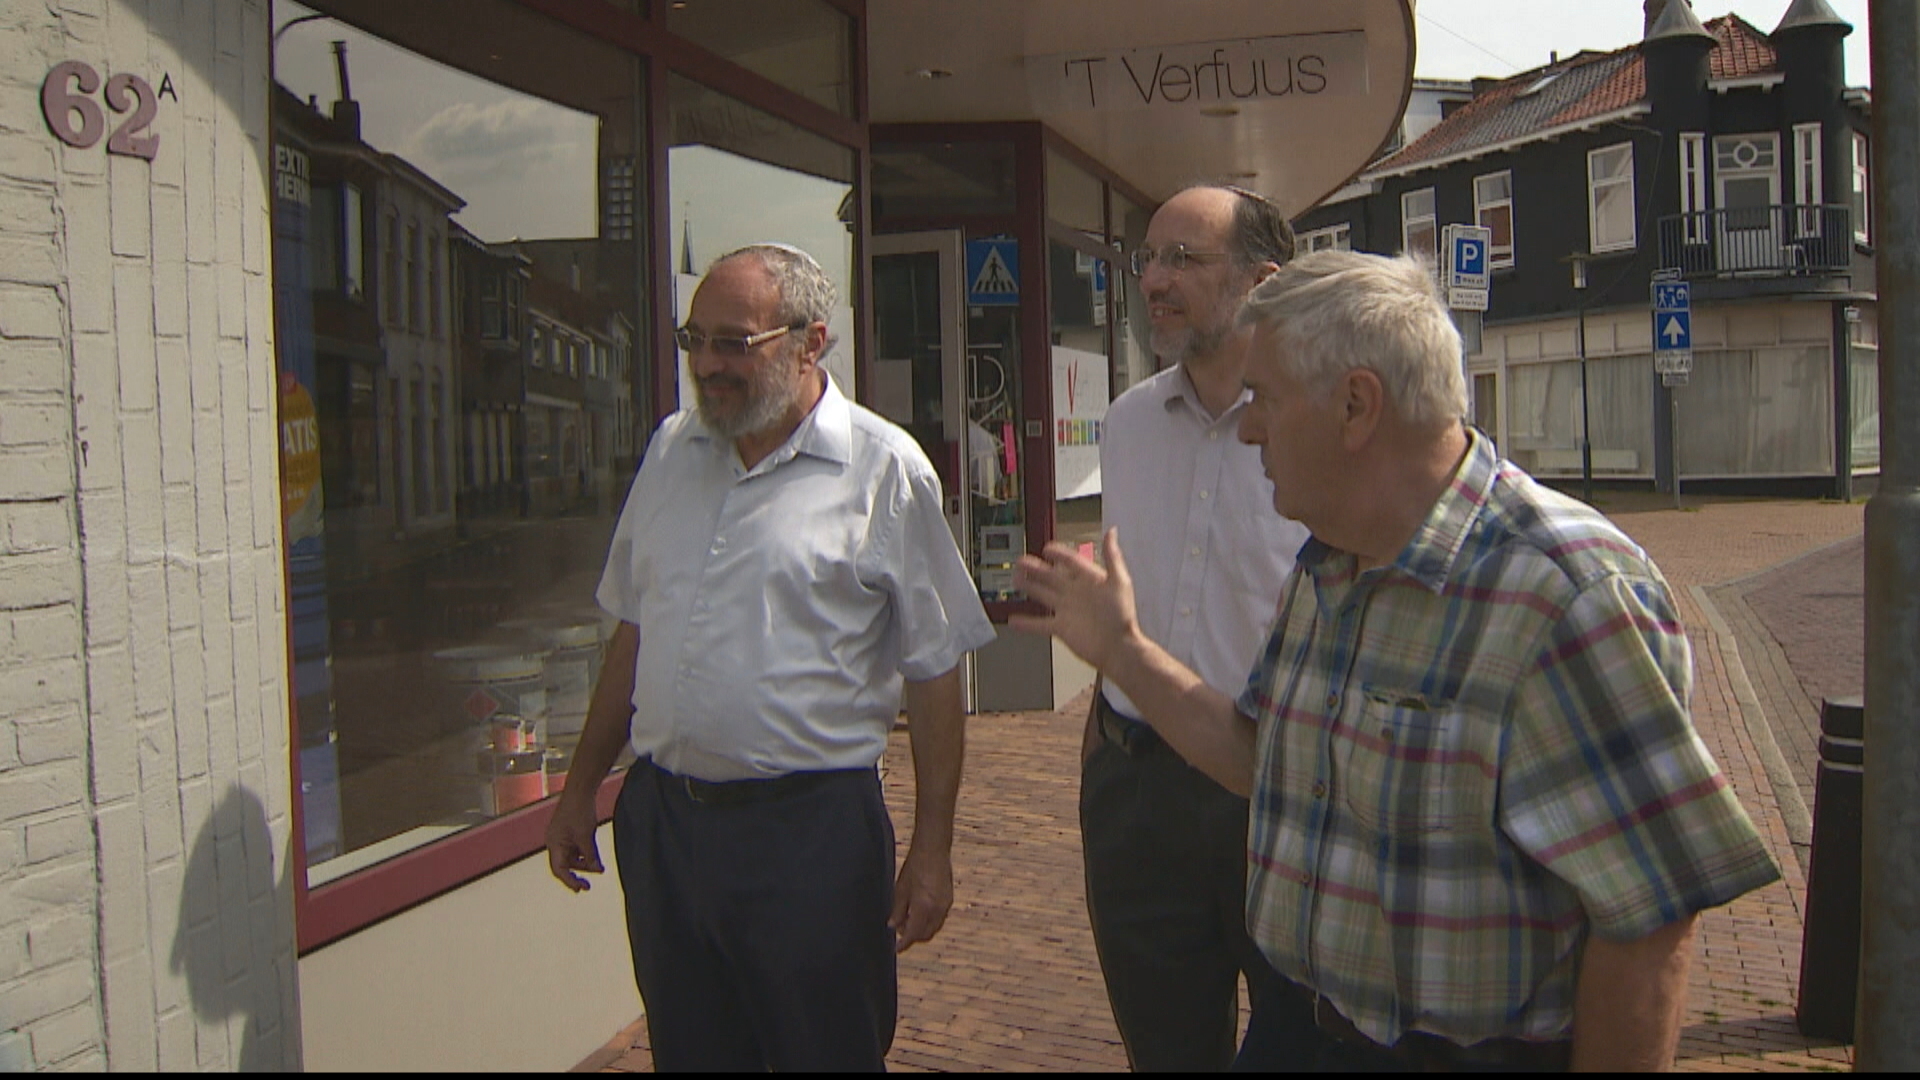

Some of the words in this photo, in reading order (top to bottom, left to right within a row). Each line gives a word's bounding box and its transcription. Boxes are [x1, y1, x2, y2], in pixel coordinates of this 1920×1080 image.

[1121, 49, 1327, 105] Verfuus
[40, 60, 159, 162] 62
[158, 70, 178, 103] A
[1461, 242, 1479, 270] P
